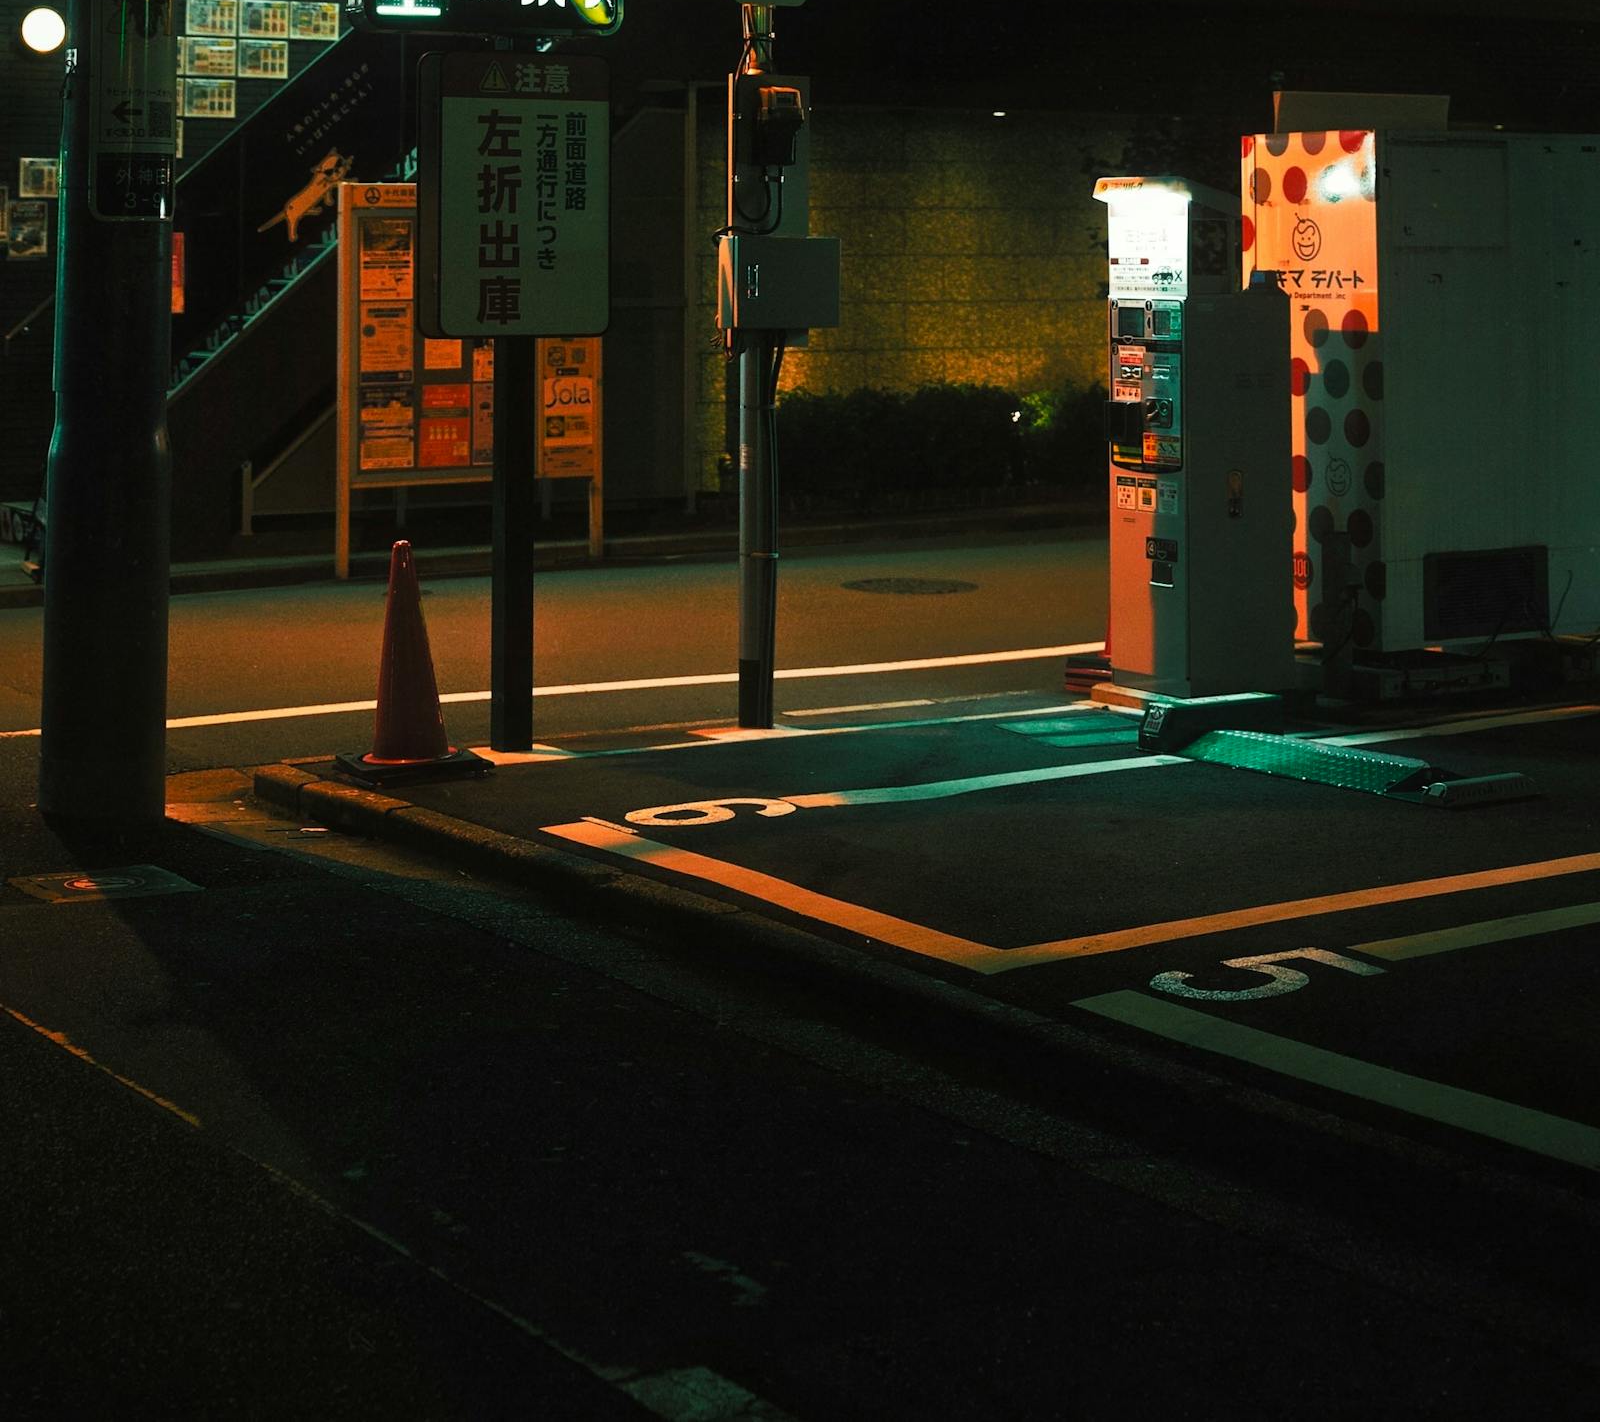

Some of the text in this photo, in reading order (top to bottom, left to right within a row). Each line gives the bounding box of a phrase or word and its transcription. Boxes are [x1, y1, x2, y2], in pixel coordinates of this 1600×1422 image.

[514, 63, 571, 94] 注意
[565, 111, 587, 211] 前面道路
[477, 108, 522, 325] 左折出庫
[536, 113, 558, 270] 一方通行につき
[1311, 270, 1364, 289] デパート
[545, 379, 591, 408] Sola
[1148, 945, 1388, 1004] 5
